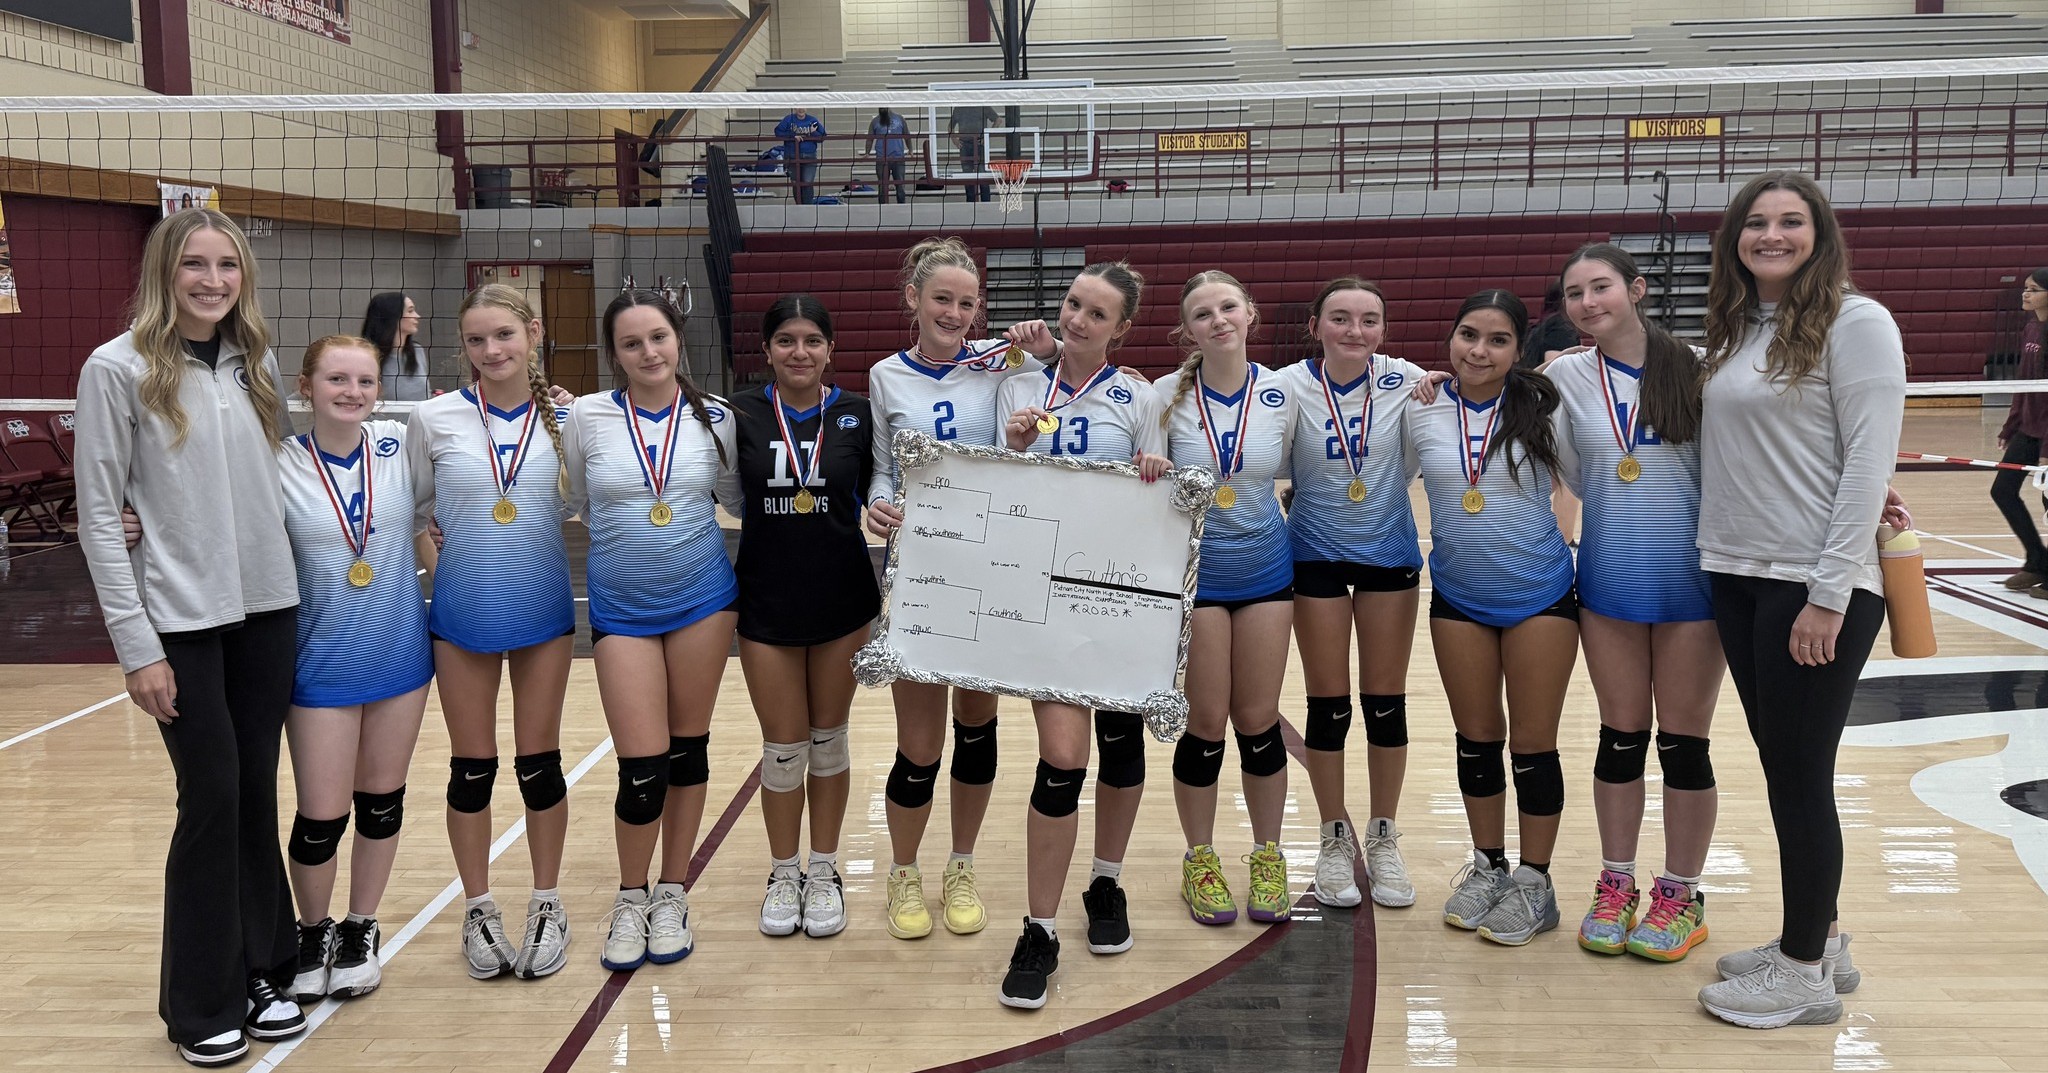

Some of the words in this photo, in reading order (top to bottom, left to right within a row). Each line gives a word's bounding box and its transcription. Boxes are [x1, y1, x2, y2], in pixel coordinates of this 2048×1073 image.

[1645, 119, 1706, 136] VISITORS
[1160, 135, 1195, 150] VISITOR
[1198, 133, 1246, 149] STUDENTS
[933, 400, 958, 441] 2
[1050, 416, 1089, 455] 13
[767, 440, 826, 487] 11
[764, 496, 829, 514] BLUEYS
[1064, 551, 1148, 589] Guthrie
[1053, 582, 1073, 593] Putnam
[1073, 585, 1086, 595] City
[1102, 590, 1116, 599] High
[1116, 591, 1134, 600] School
[988, 606, 1023, 621] Guthrie
